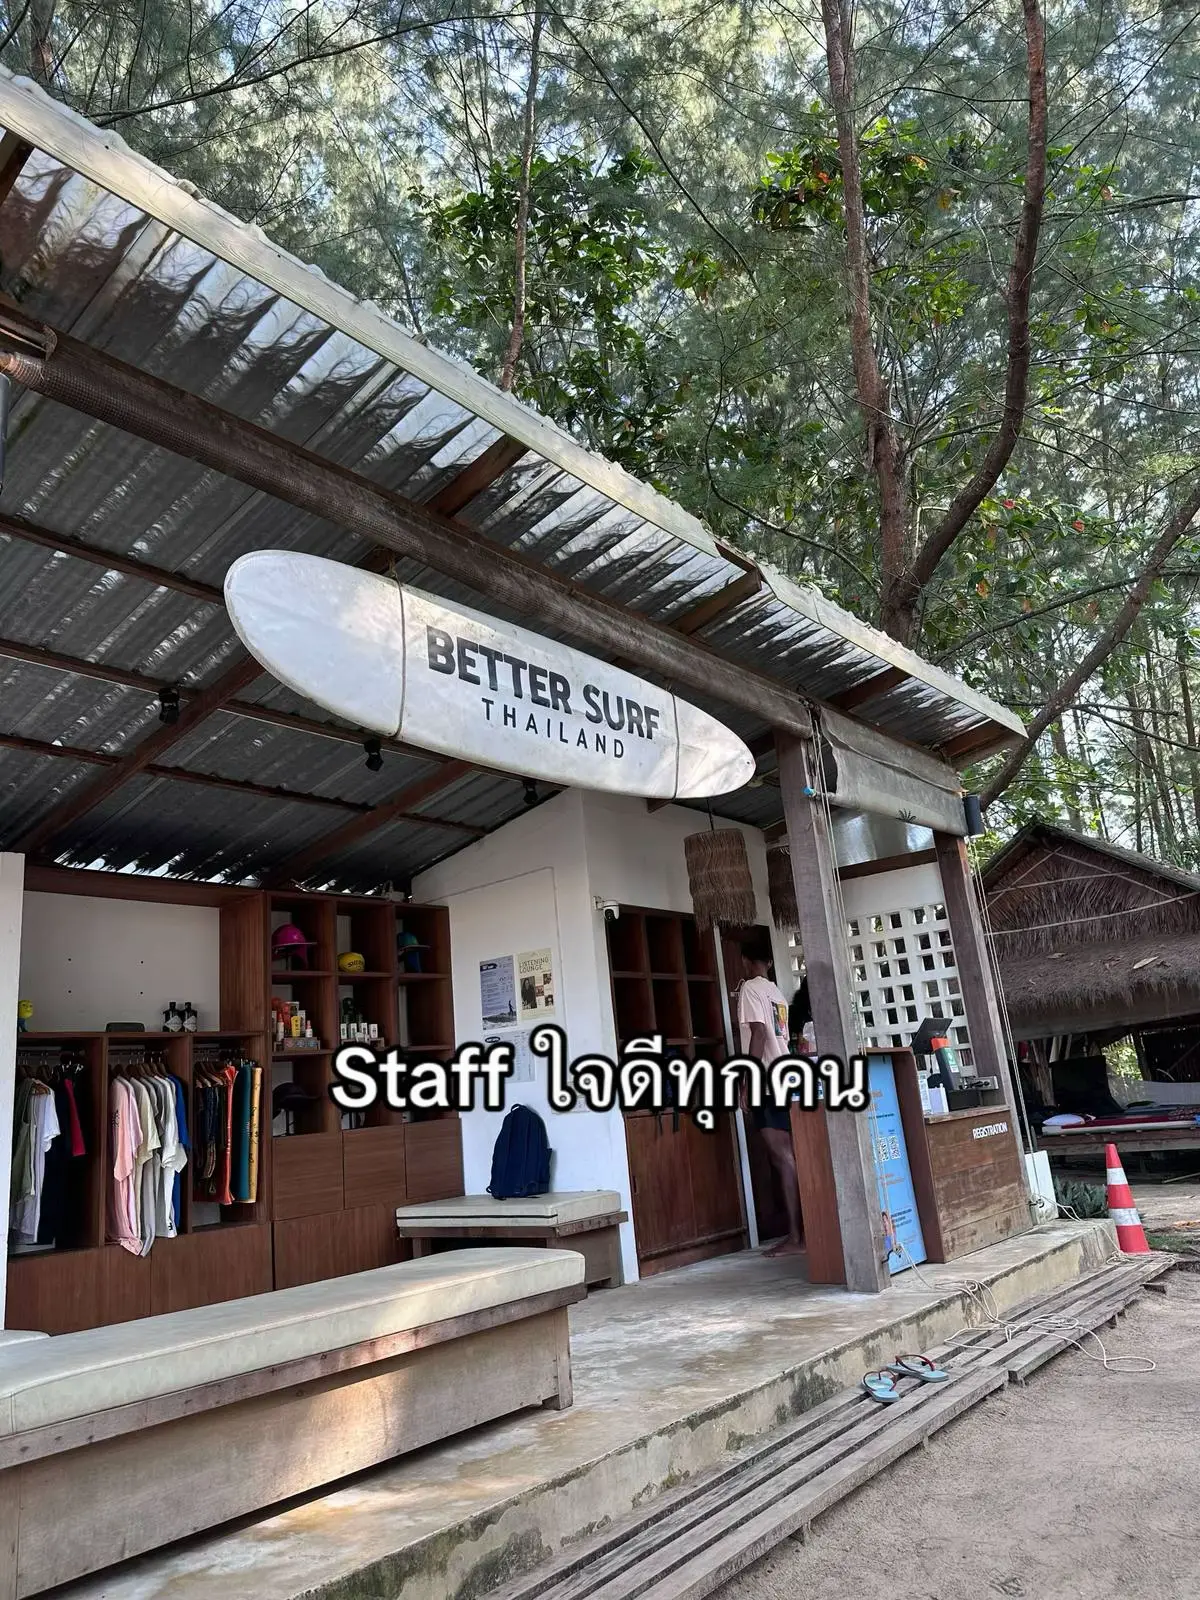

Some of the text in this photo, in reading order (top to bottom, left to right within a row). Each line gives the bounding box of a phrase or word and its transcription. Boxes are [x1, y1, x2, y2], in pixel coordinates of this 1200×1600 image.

[427, 625, 661, 740] BETTER SURF
[481, 697, 625, 759] THAILAND
[519, 956, 549, 968] LISTENING
[519, 964, 543, 974] LOUNGE
[972, 1121, 1009, 1140] REGISTRATION
